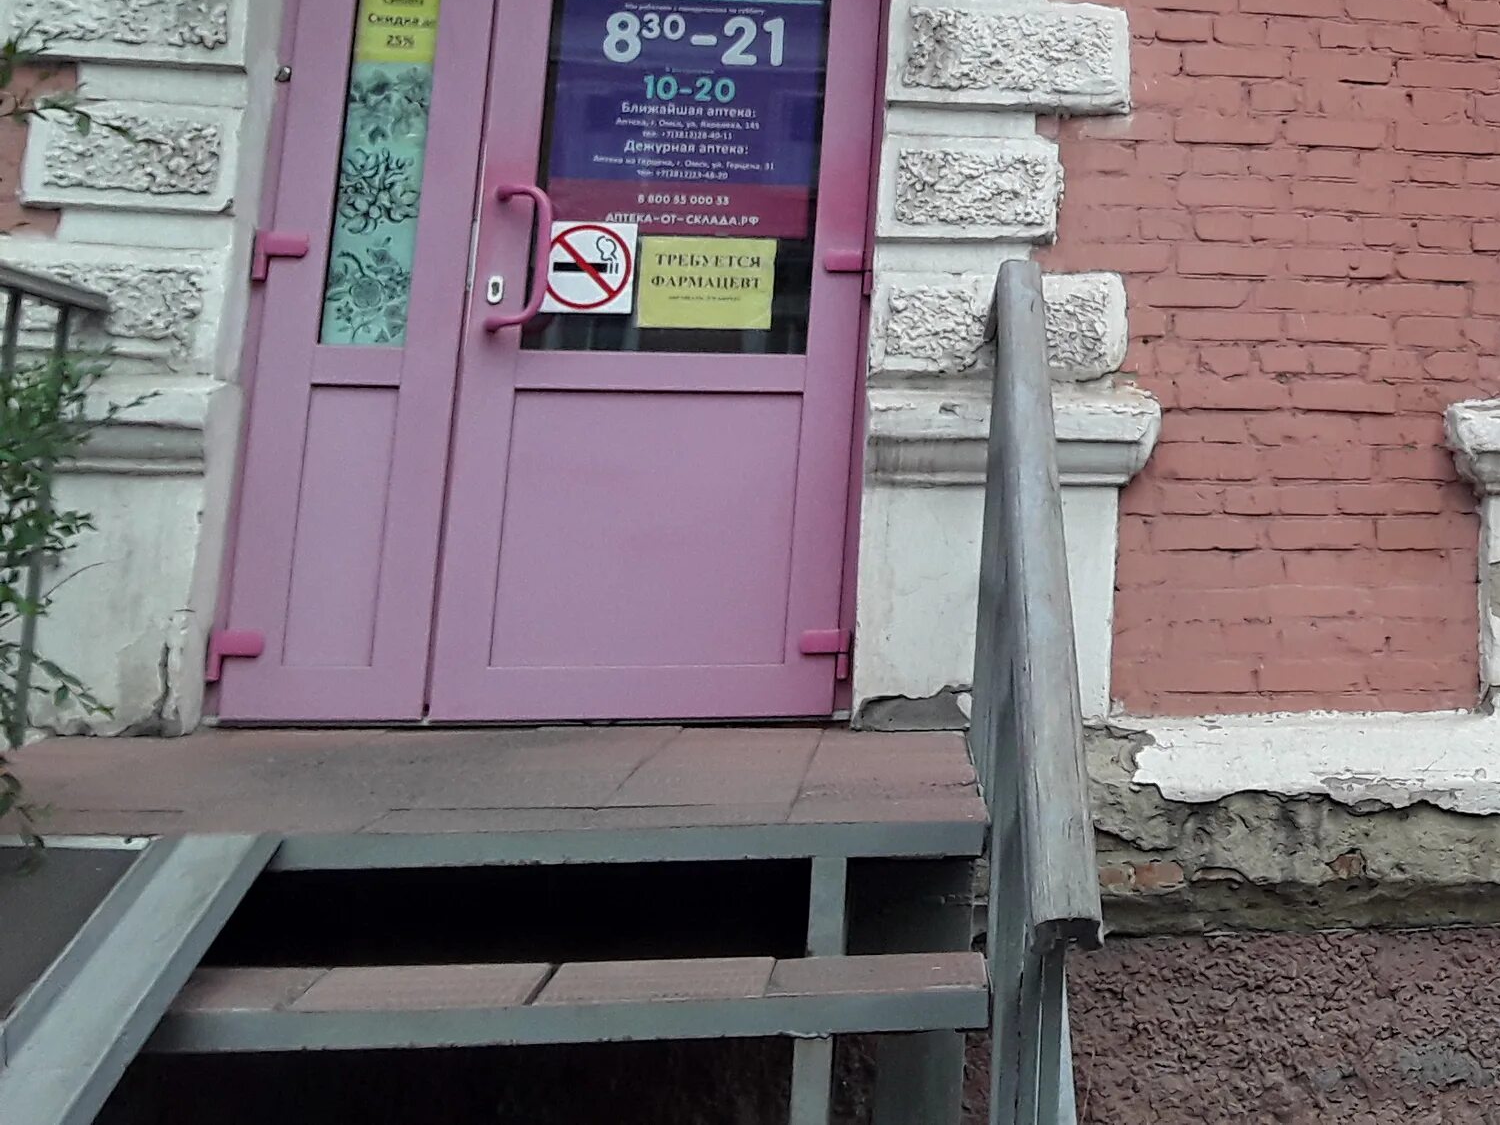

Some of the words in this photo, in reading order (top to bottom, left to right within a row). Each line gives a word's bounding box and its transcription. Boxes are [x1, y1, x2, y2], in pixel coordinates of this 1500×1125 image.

[643, 74, 736, 103] 10-20
[621, 101, 703, 117] Ближайшая
[623, 139, 695, 155] Дежурная
[699, 144, 749, 155] аптека:
[655, 253, 761, 268] ТРЕБУЕТСЯ
[651, 275, 760, 290] ФАРМАЦЕВТ
